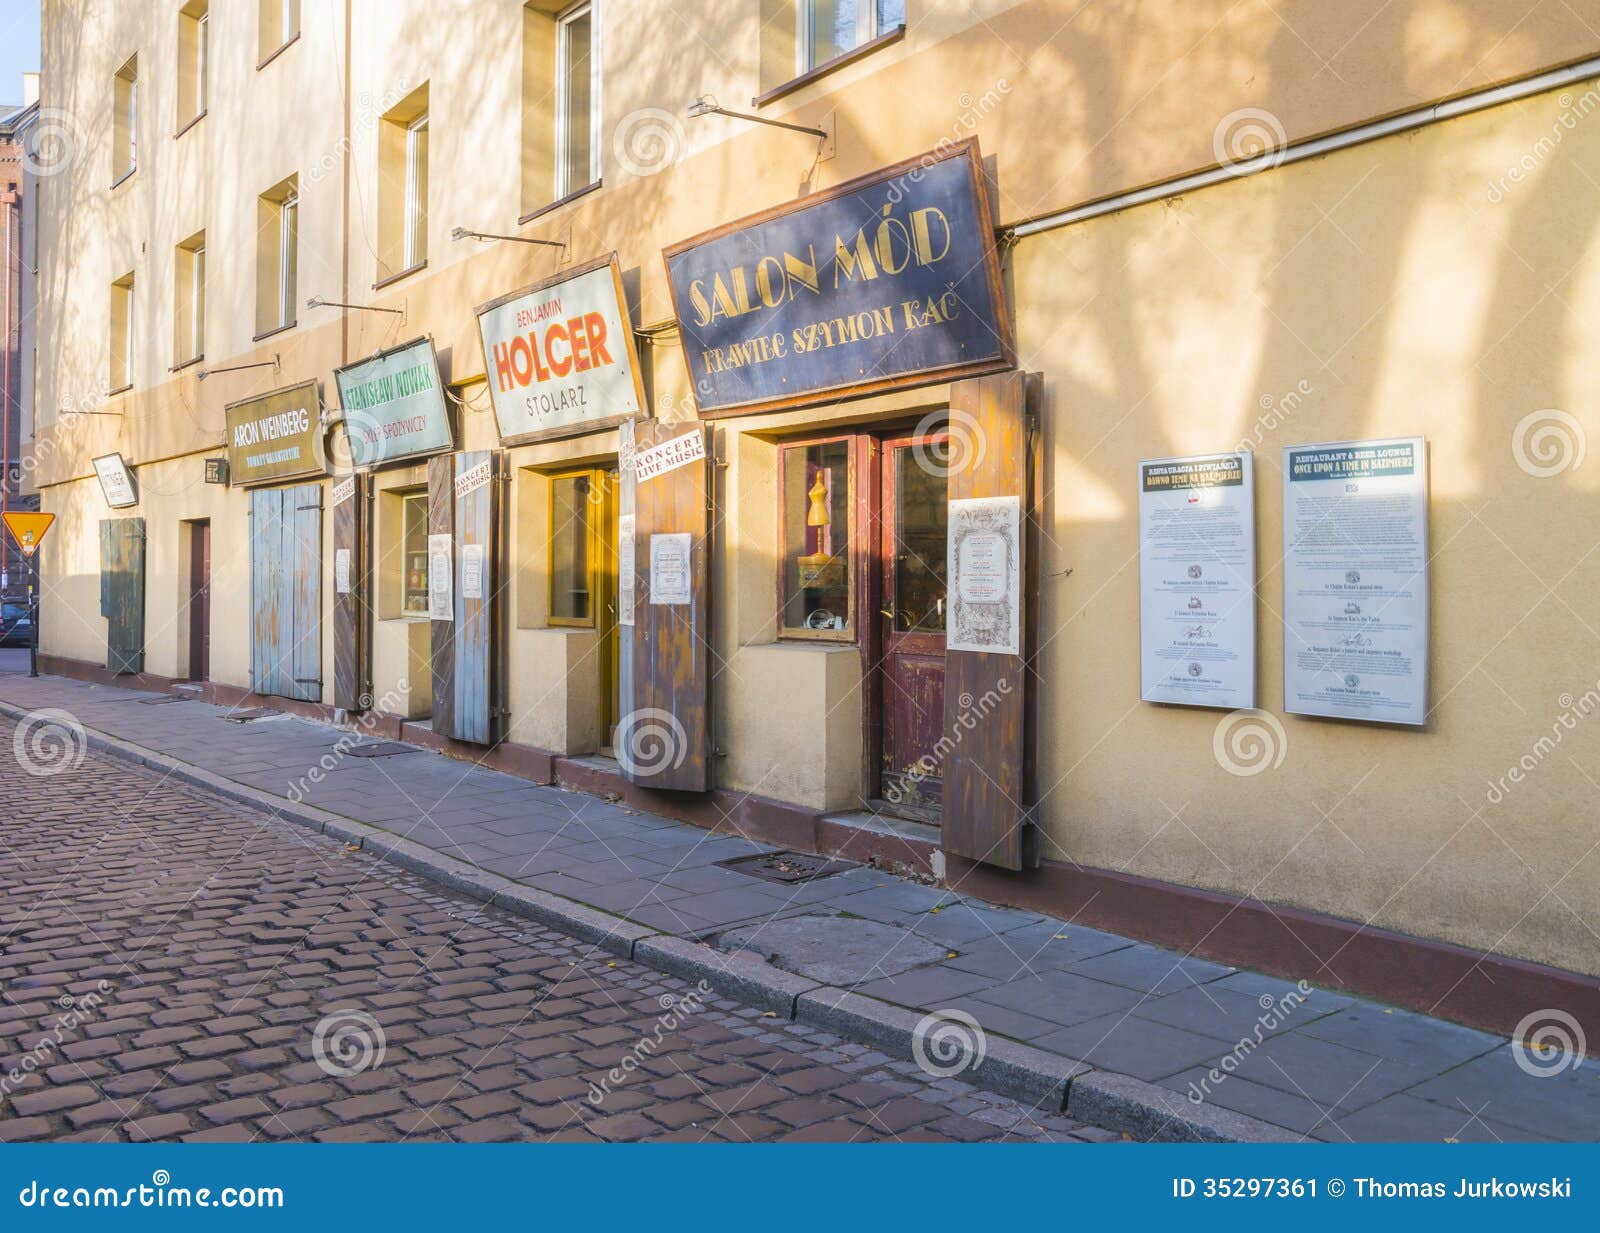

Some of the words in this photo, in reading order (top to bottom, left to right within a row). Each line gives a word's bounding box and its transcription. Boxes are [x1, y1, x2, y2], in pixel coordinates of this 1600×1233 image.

[688, 244, 822, 328] SALON
[833, 203, 951, 289] MÓD
[516, 298, 562, 328] BENJAMIN
[493, 311, 616, 393] HOLCER
[702, 333, 788, 374] KRAWIEC
[792, 307, 894, 354] SZYMON
[395, 363, 432, 398] NOWAK
[526, 385, 587, 417] STOLARZ
[234, 420, 260, 448] ARON
[259, 408, 309, 441] WEINBERG
[636, 435, 701, 468] KONCERT
[638, 462, 663, 478] LIVE
[665, 446, 703, 468] MUSIC
[1294, 463, 1312, 474] ONCE
[1313, 462, 1334, 473] UPON
